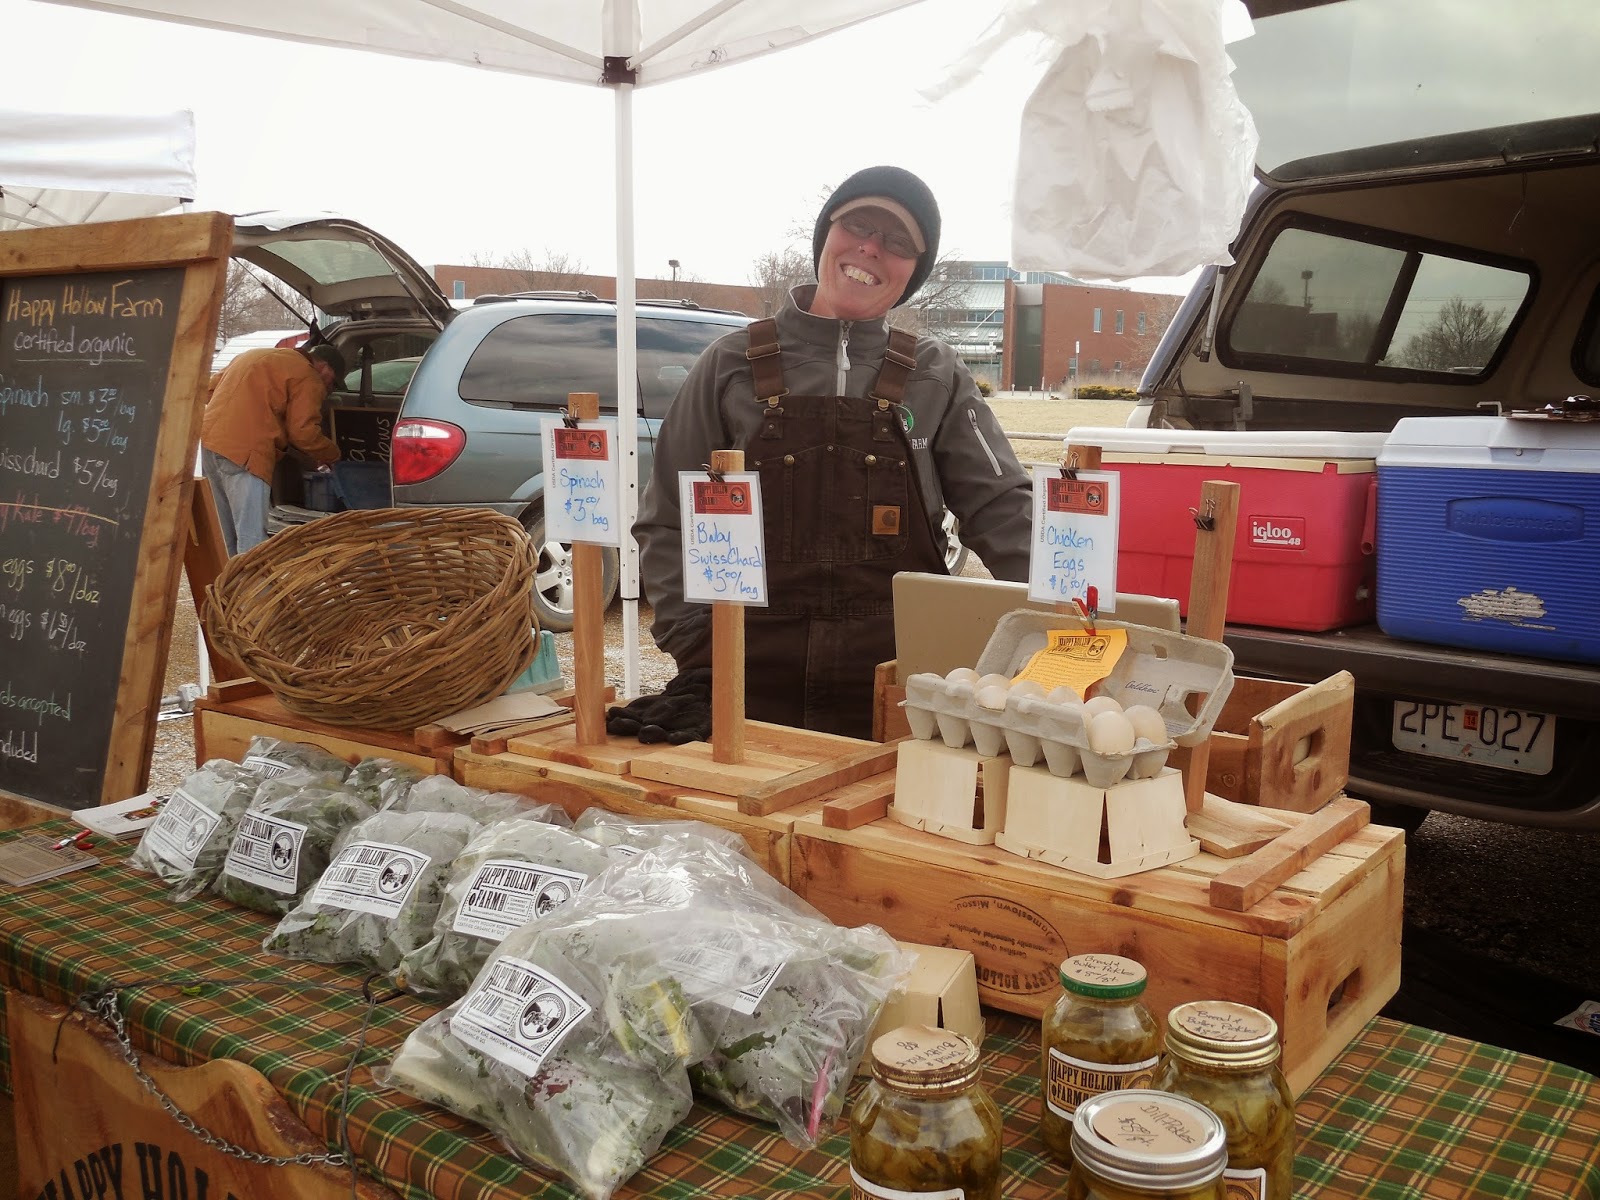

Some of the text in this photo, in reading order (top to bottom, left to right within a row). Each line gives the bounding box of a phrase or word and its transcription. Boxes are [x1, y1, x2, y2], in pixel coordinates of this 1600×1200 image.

[7, 279, 163, 326] Happy Hollow Farm
[14, 325, 137, 366] certified organic
[560, 468, 605, 495] Spinach
[697, 521, 732, 547] Baby
[1047, 525, 1094, 550] Chicken
[1253, 521, 1292, 541] igloo
[1288, 537, 1301, 546] 48
[3, 558, 34, 592] eggs
[1053, 551, 1085, 579] Eggs
[8, 609, 31, 641] eggs
[18, 688, 72, 727] accepted
[1479, 706, 1546, 753] 027
[473, 867, 541, 891] HAPPY HOLLOW
[474, 890, 501, 911] FARM
[1050, 1057, 1123, 1091] HAPPY HOLLOW
[1057, 1083, 1081, 1106] FARM
[36, 1143, 122, 1200] APPY
